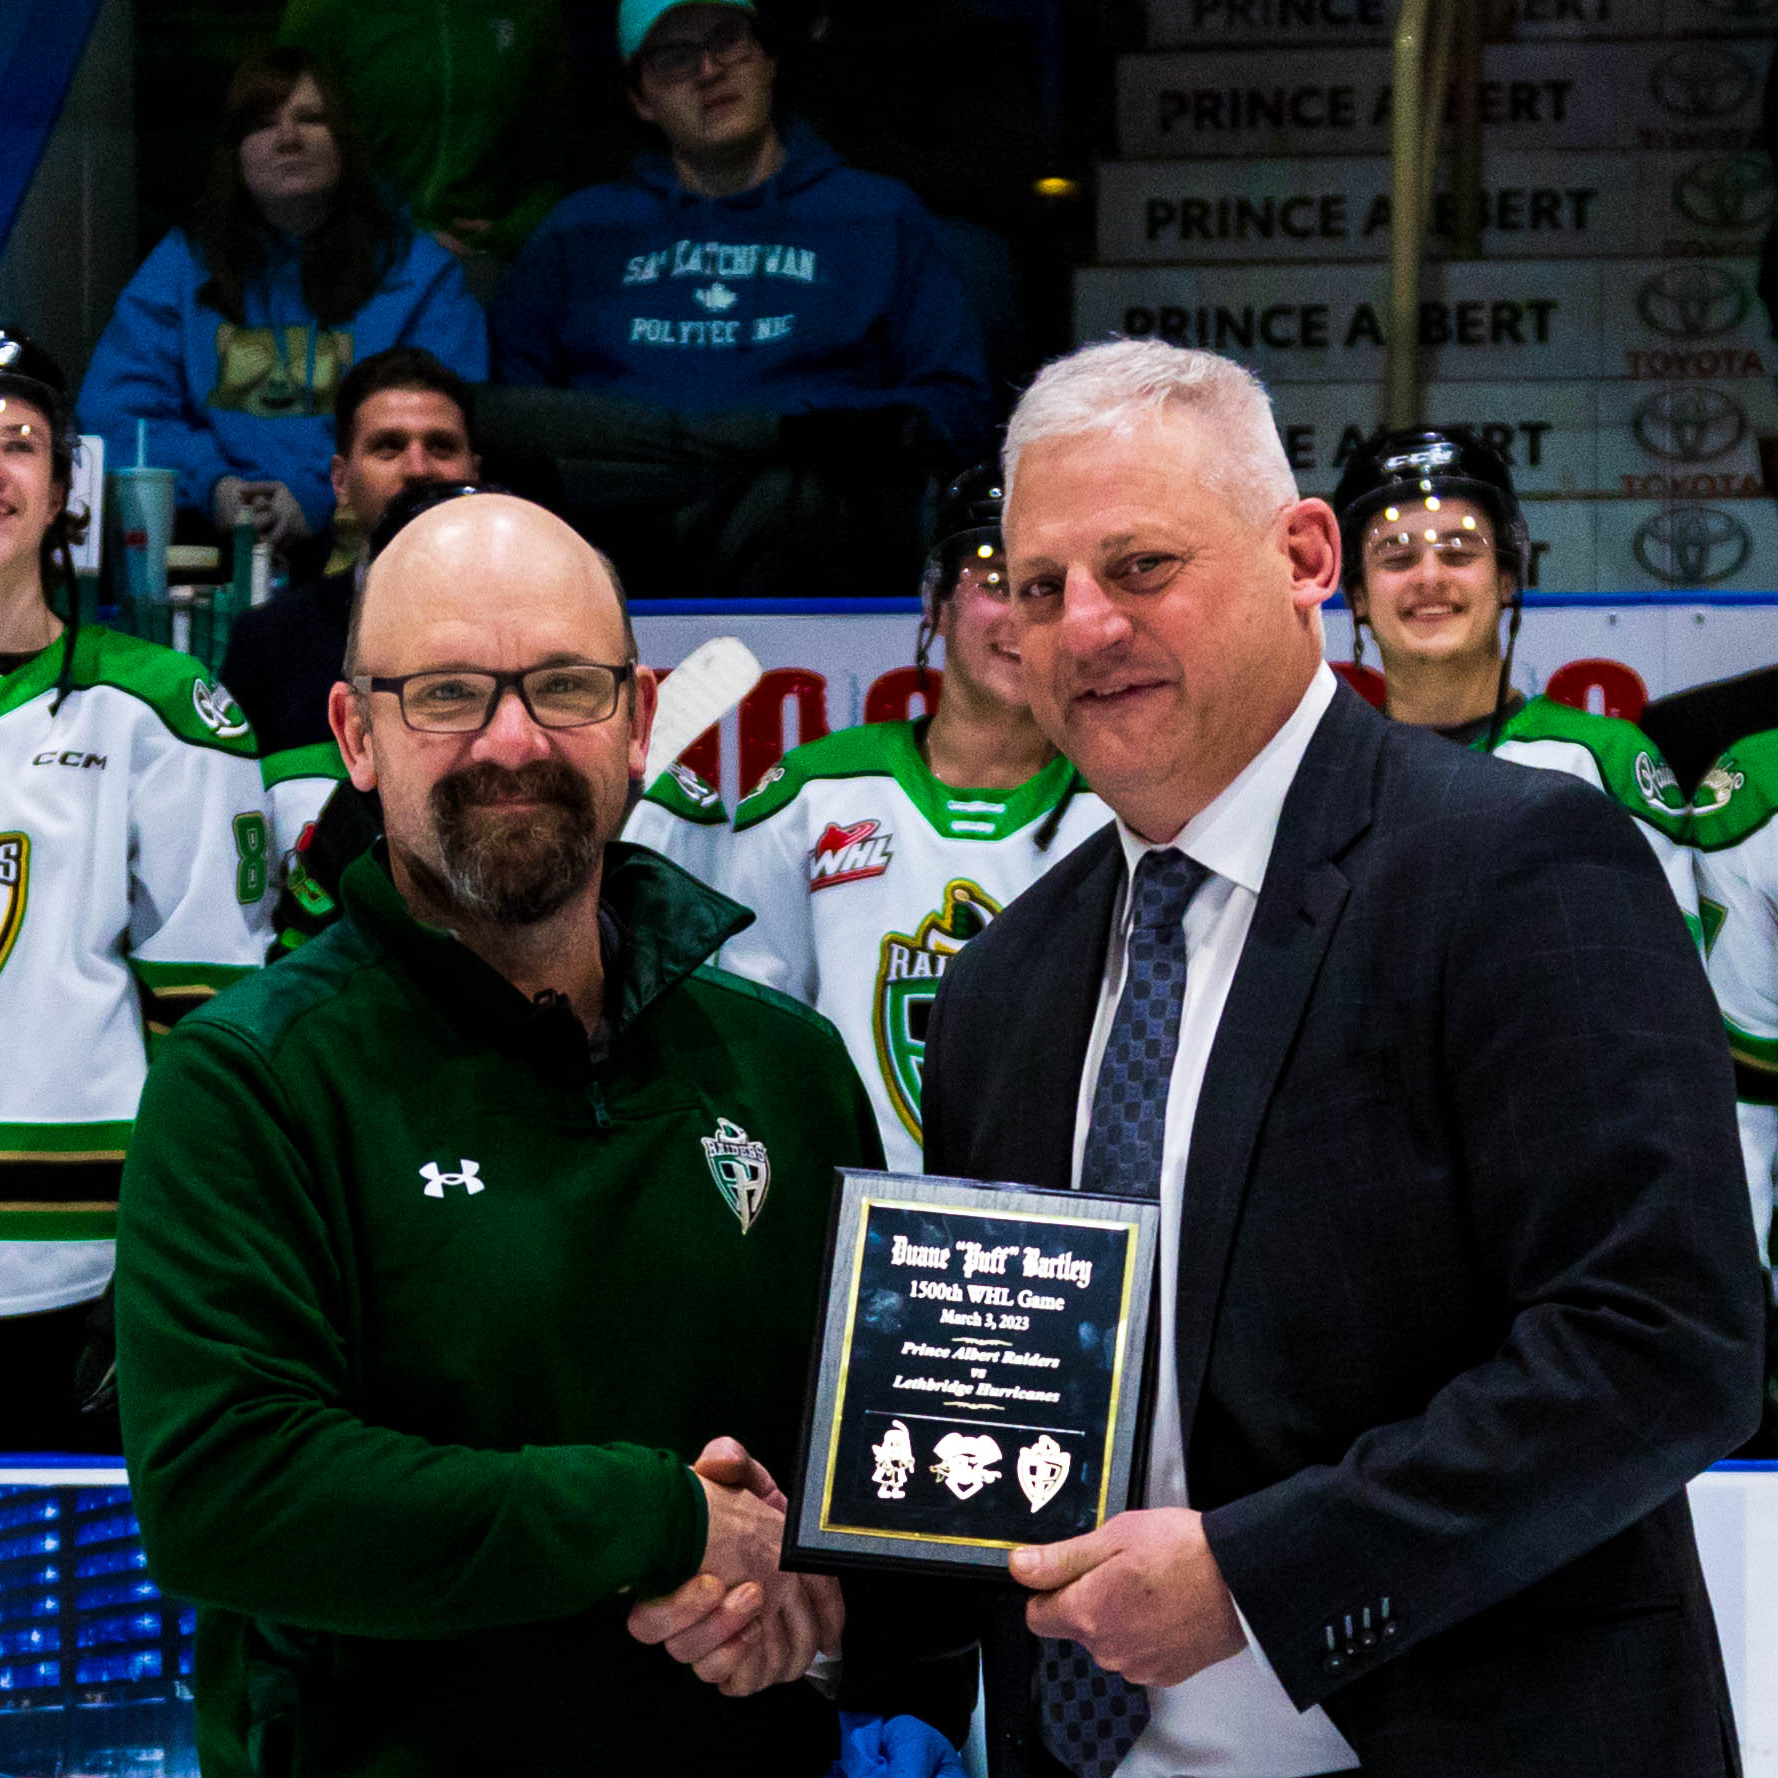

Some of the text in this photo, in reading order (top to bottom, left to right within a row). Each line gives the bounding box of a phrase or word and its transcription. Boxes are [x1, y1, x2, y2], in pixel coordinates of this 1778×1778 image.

[1160, 86, 1354, 131] PRINCE
[1146, 195, 1347, 241] PRINCE
[1123, 301, 1558, 349] PRINCE ABERT
[1625, 350, 1765, 380] TOYOTA
[1621, 473, 1766, 498] TOYOTA
[32, 750, 106, 770] CCM
[811, 833, 894, 880] WHL
[707, 1141, 767, 1163] RAIDERS
[891, 1235, 950, 1270] Duane
[909, 1280, 1065, 1312] 1500th WHL Game
[940, 1308, 983, 1328] March
[998, 1314, 1030, 1331] 2023
[901, 1341, 1061, 1369] Prince Albert Raiders
[970, 1367, 988, 1380] vs
[892, 1374, 1061, 1404] Lethbridge Hurricanes
